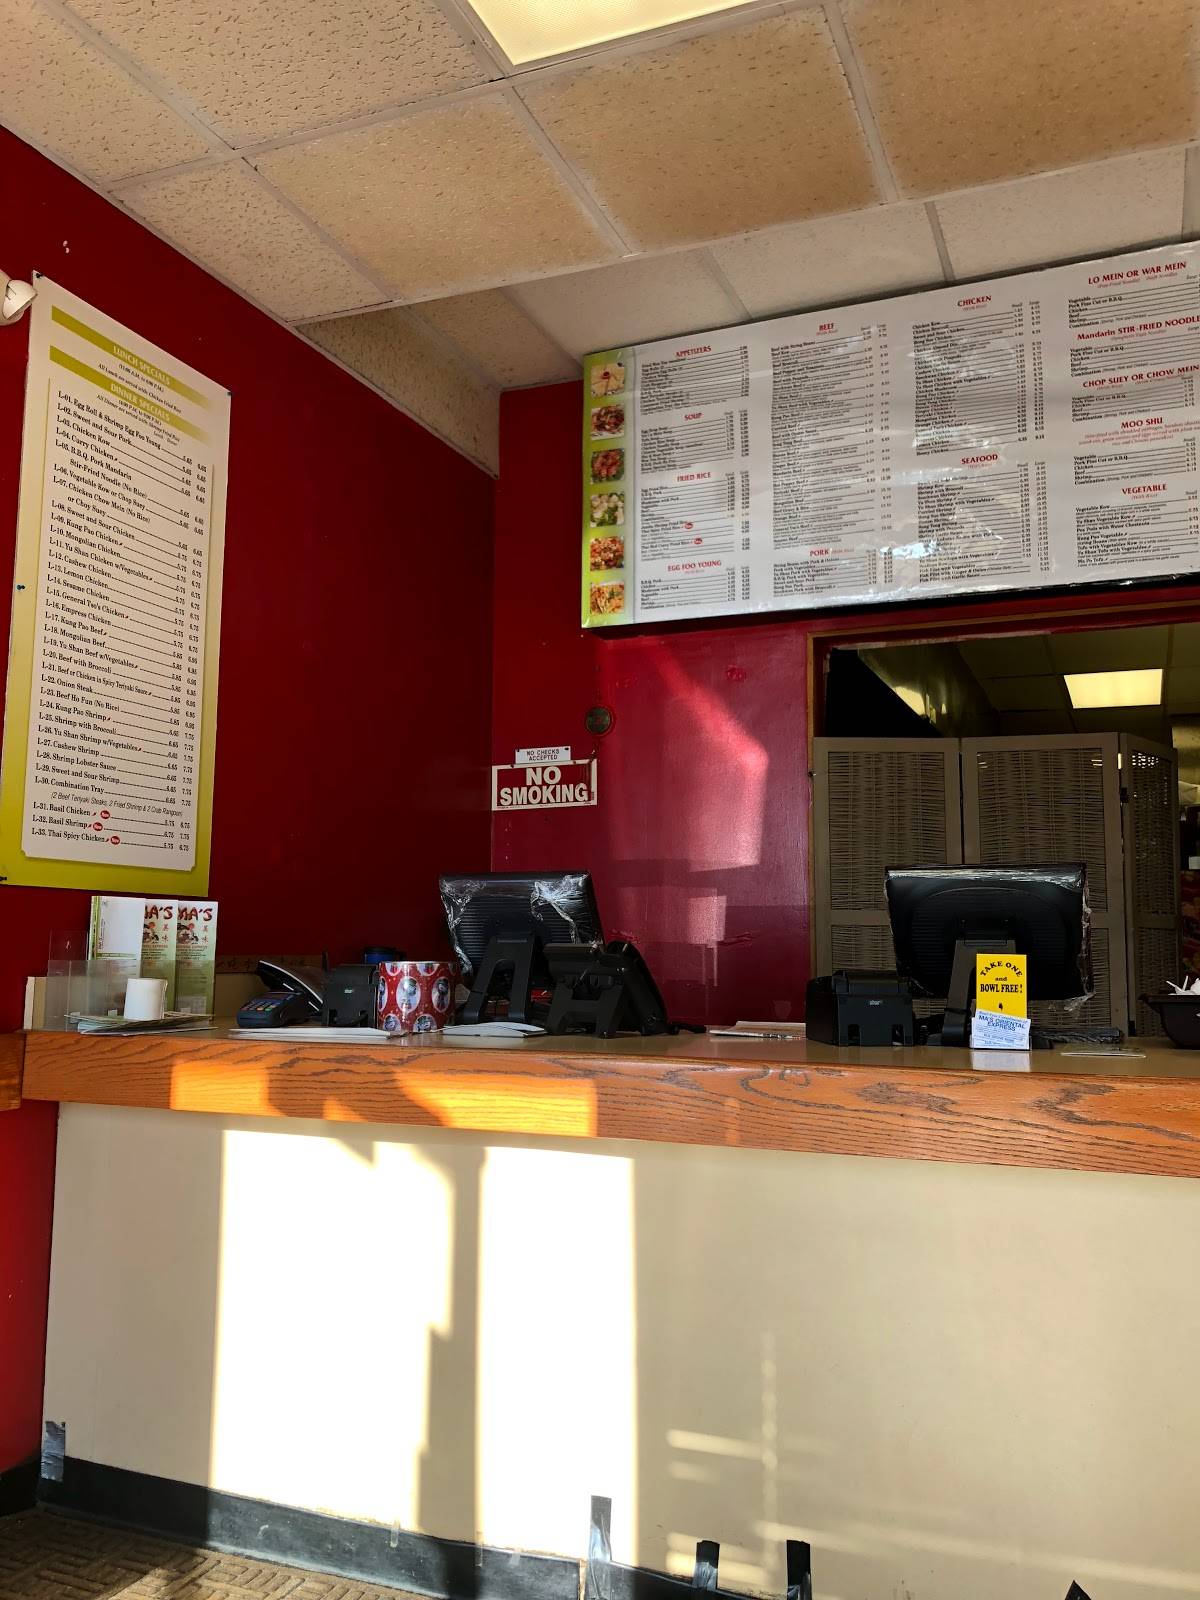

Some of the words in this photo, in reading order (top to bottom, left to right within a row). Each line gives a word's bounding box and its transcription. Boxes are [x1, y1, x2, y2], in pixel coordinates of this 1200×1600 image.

[1103, 272, 1124, 282] MEIN
[1126, 270, 1138, 278] OR
[1142, 266, 1161, 275] WAR
[1165, 262, 1186, 272] MEIN
[958, 295, 992, 306] CHICKEN
[819, 323, 834, 331] BEEF
[1077, 329, 1115, 340] Mandarin
[113, 346, 138, 366] LUNCH
[140, 362, 169, 385] SPECIALS
[1083, 378, 1106, 387] CHOP
[1109, 375, 1128, 384] SUEY
[1132, 372, 1144, 380] OR
[1147, 368, 1174, 379] CHOW
[110, 383, 136, 403] DINNER
[138, 398, 170, 421] SPECIALS
[684, 413, 702, 421] SOUP
[1121, 420, 1143, 428] MOO
[1146, 417, 1163, 426] SHU
[71, 422, 96, 440] Chicken
[72, 410, 91, 425] Sweet
[91, 421, 103, 431] and
[103, 425, 117, 438] Sour
[118, 433, 131, 445] Pork
[71, 434, 89, 449] Curry
[89, 443, 114, 460] Chicken
[89, 455, 104, 468] Pork
[104, 462, 132, 480] Mandarin
[961, 454, 998, 464] SEAFOOD
[677, 474, 694, 482] FRIED
[1122, 484, 1167, 494] VEGETABLE
[64, 530, 96, 548] Mongolian
[97, 543, 121, 558] Chicken
[63, 554, 87, 568] Cashew
[87, 563, 111, 578] Chicken
[668, 564, 680, 572] EGG
[698, 560, 721, 568] YOUNG
[61, 591, 86, 605] General
[101, 604, 125, 618] Chicken
[60, 615, 76, 629] Kung
[77, 621, 89, 631] Pao
[89, 624, 103, 635] Beef
[59, 627, 91, 644] Mongolian
[91, 637, 106, 648] Beef
[57, 652, 72, 663] Beef
[72, 658, 87, 667] with
[87, 660, 111, 674] Broccoli
[55, 677, 75, 689] Onion
[76, 682, 93, 693] Steak
[55, 690, 71, 700] Beef
[70, 693, 80, 702] Ho
[93, 699, 104, 708] (No
[104, 702, 119, 711] Rice)
[54, 715, 77, 728] Shrimp
[77, 721, 92, 730] with
[92, 723, 117, 735] Broccoli
[52, 740, 77, 751] Cashew
[77, 745, 99, 757] Shrimp
[51, 752, 75, 765] Shrimp
[75, 757, 98, 768] Lobster
[99, 761, 116, 771] Sauce
[51, 765, 70, 775] Sweet
[83, 770, 98, 780] Sour
[98, 773, 120, 785] Shrimp
[526, 766, 561, 785] NO
[50, 778, 90, 791] Combination
[90, 784, 104, 794] Tray
[500, 783, 588, 806] SMOKING
[48, 803, 65, 812] Basil
[65, 805, 90, 816] Chicken
[57, 791, 70, 800] Beef
[113, 800, 125, 808] Fried
[125, 801, 142, 812] Shrimp
[47, 816, 64, 825] Basil
[64, 818, 88, 829] Shrimp
[47, 828, 62, 838] Thai
[62, 830, 80, 840] Spicy
[80, 832, 105, 842] Chicken
[980, 961, 1003, 976] TAKE
[1006, 963, 1022, 977] ONE
[980, 984, 1000, 992] BOWL
